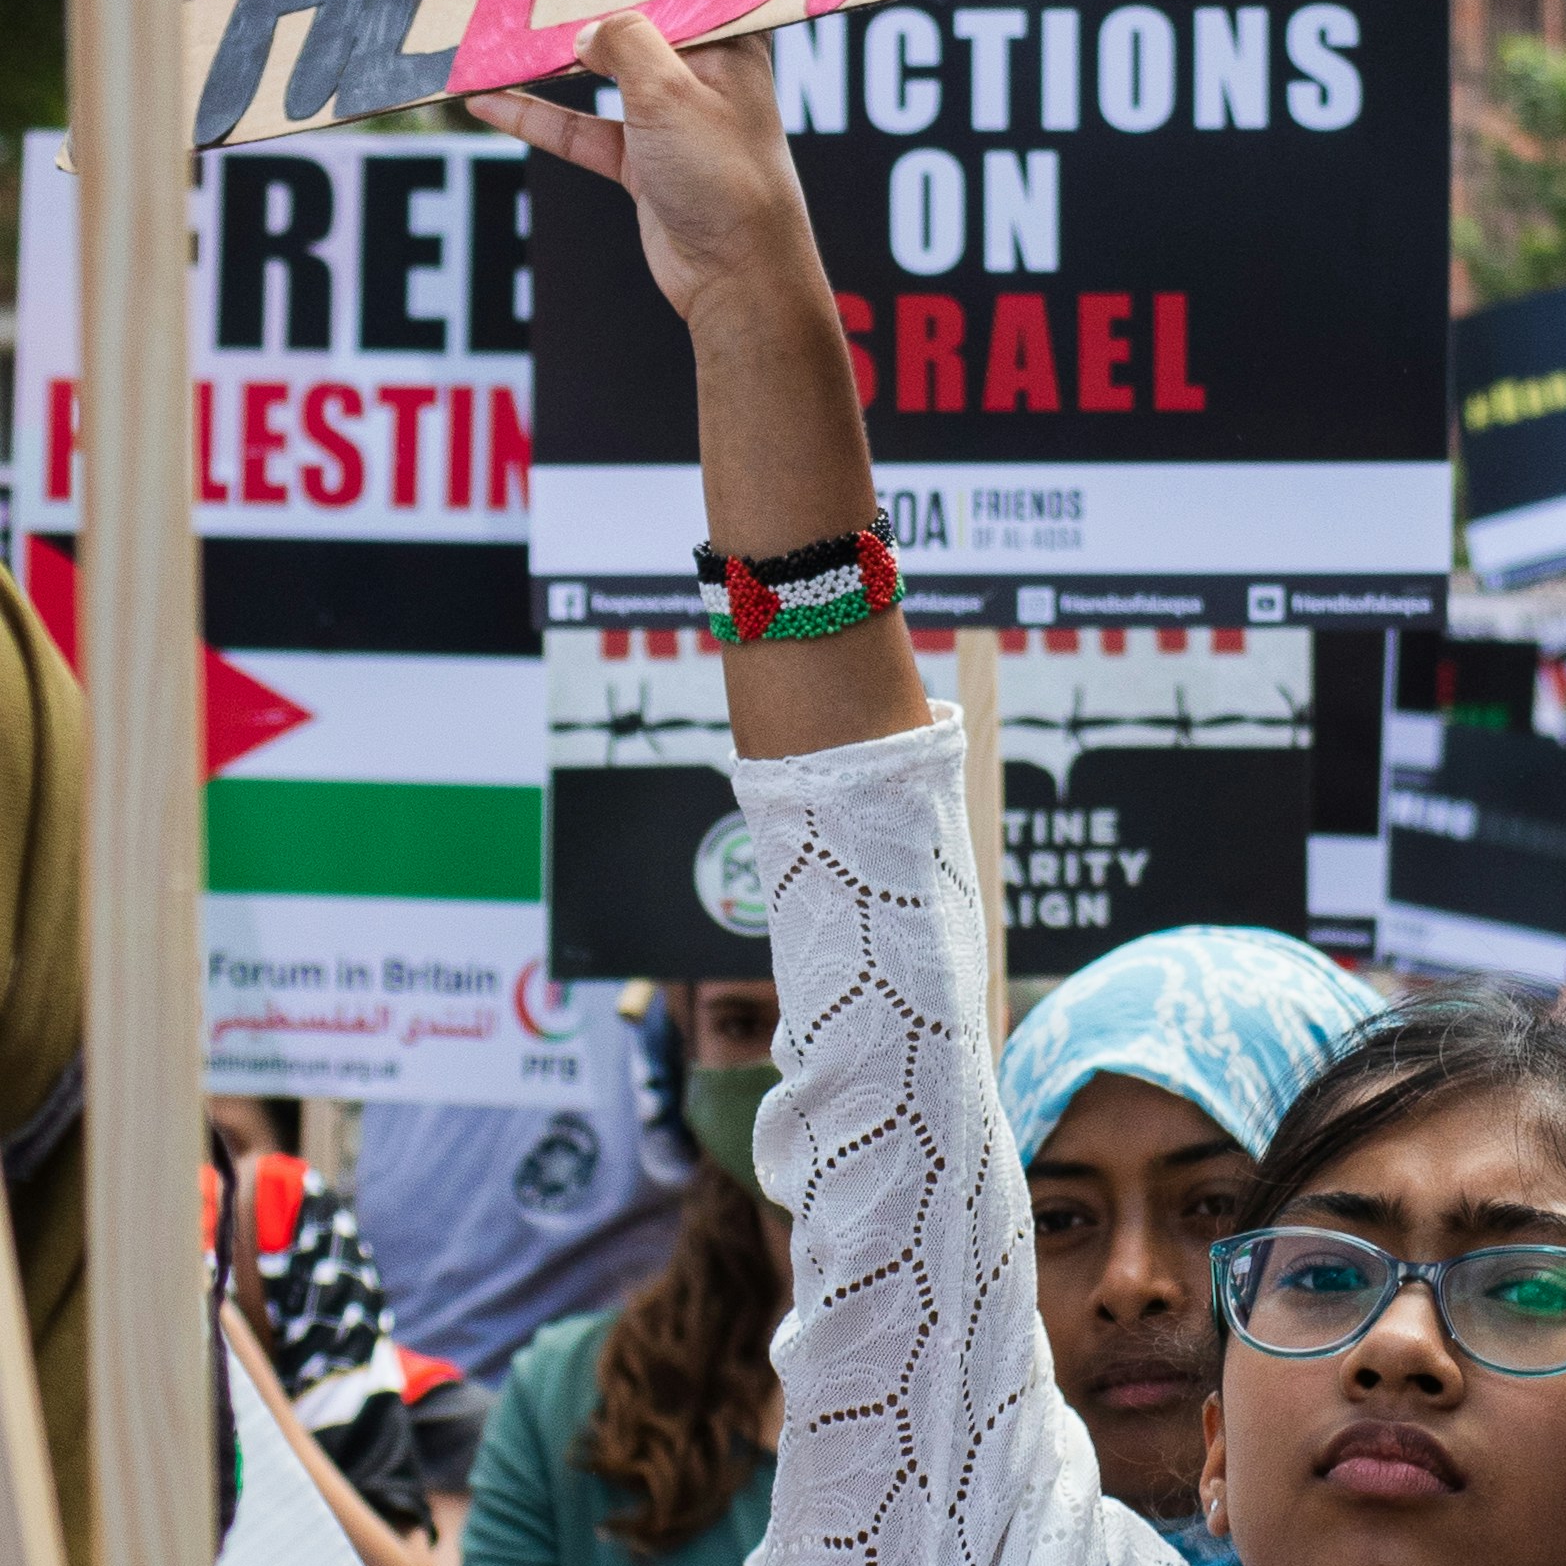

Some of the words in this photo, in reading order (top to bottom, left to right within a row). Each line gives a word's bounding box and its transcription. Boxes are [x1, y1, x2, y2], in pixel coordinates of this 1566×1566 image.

[775, 3, 1363, 134] NCTIONS
[190, 153, 531, 353] REE
[888, 147, 1061, 276] ON
[832, 291, 1207, 414] SRAEL
[47, 379, 531, 510] LESTIN
[971, 488, 1083, 522] FRIENDS
[209, 953, 324, 990] Forum
[337, 955, 368, 990] in
[382, 956, 497, 995] Britain
